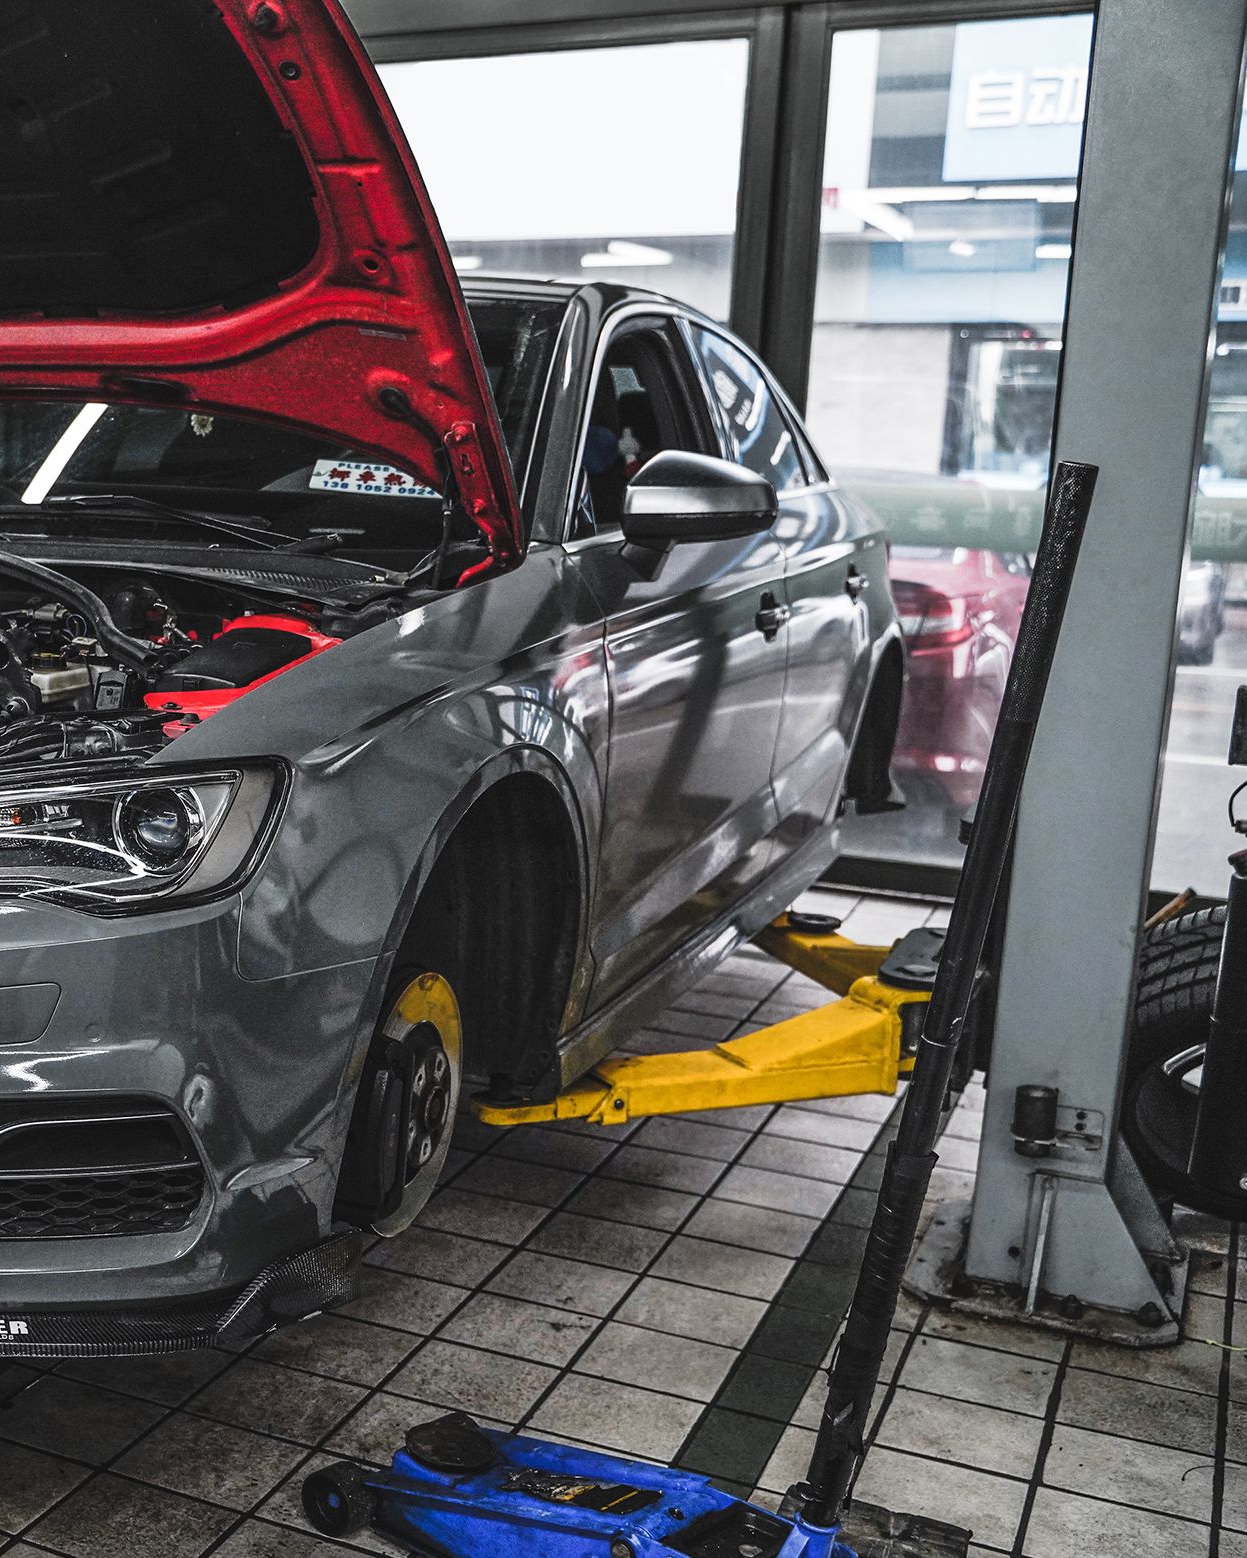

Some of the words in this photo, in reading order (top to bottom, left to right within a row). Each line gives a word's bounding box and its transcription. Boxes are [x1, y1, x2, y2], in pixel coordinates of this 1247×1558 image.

[337, 462, 391, 472] PLEASE
[322, 480, 350, 490] 138
[398, 487, 436, 496] 0924
